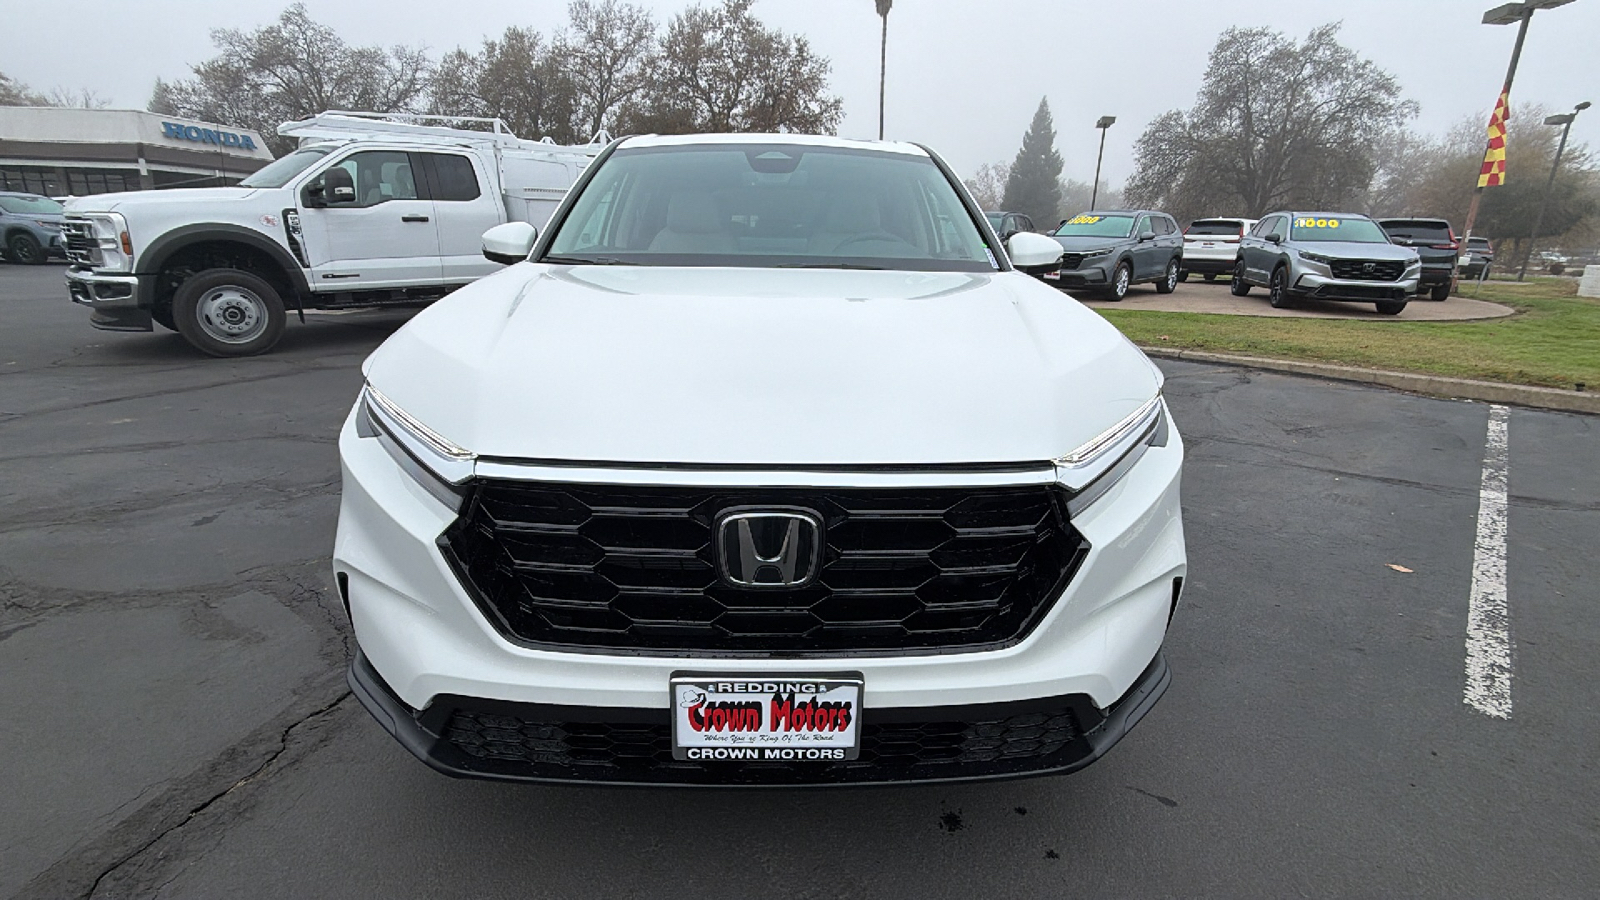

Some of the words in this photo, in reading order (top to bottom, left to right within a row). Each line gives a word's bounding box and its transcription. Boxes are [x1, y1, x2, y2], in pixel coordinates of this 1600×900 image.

[162, 121, 257, 151] HONDA
[718, 683, 816, 694] REDDING
[687, 695, 762, 732] Crown
[770, 693, 852, 732] Motors
[704, 734, 728, 742] Where
[730, 734, 756, 744] You're
[759, 734, 779, 743] King
[782, 734, 793, 743] Of
[795, 733, 809, 741] The
[687, 748, 760, 760] CROWN
[764, 748, 845, 760] MOTORS
